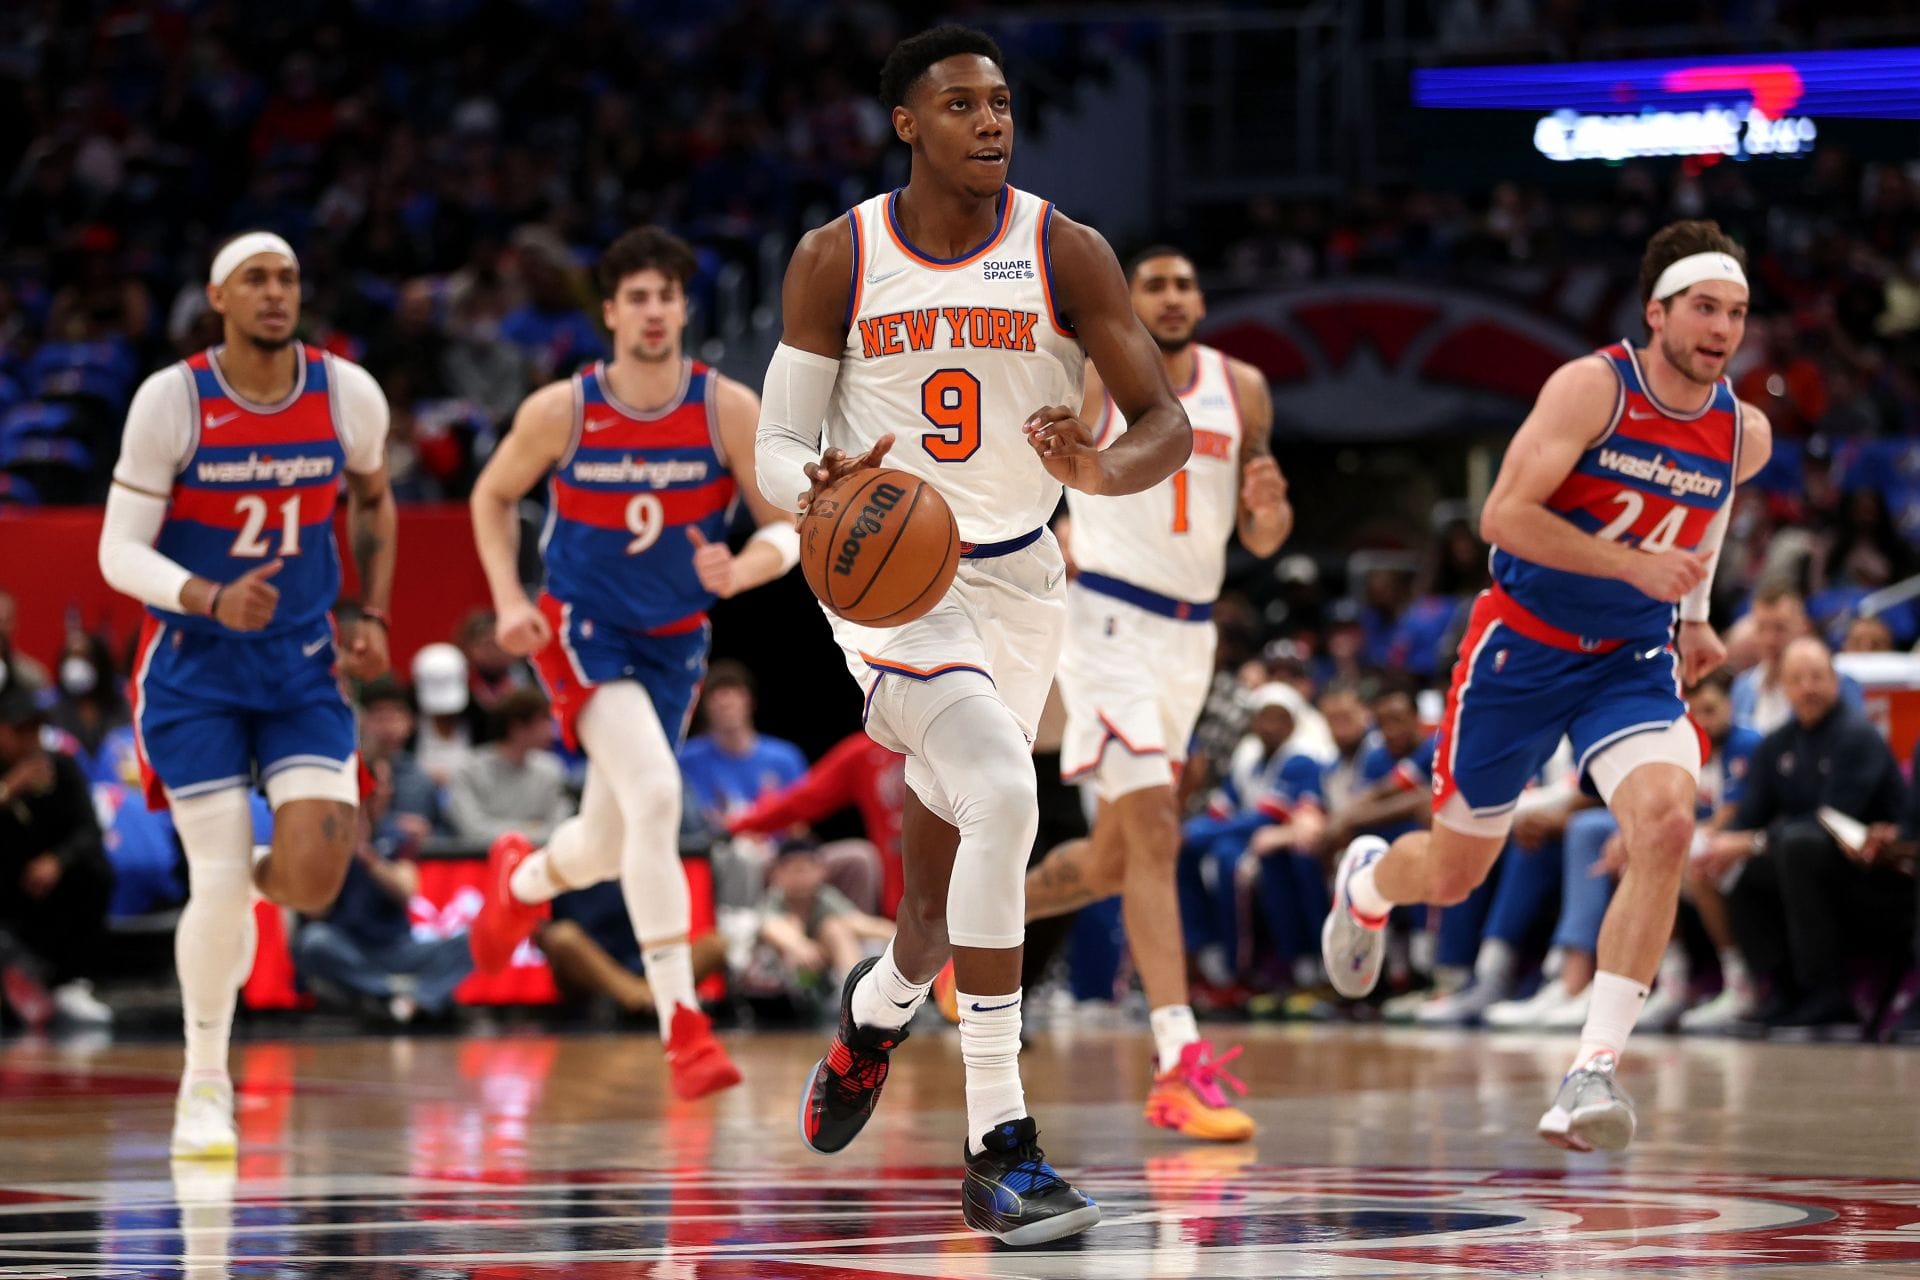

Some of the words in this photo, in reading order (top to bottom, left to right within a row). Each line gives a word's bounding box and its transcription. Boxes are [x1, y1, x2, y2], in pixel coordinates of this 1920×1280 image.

[983, 260, 1032, 270] SQUARE
[983, 270, 1023, 280] SPACE
[858, 308, 939, 358] NEW
[943, 307, 1038, 352] YORK
[921, 368, 981, 463] 9
[1172, 469, 1190, 534] 1
[1598, 448, 1723, 498] washington
[228, 494, 303, 558] 21
[624, 493, 664, 556] 9
[833, 483, 906, 576] Wilson
[1595, 490, 1689, 554] 24
